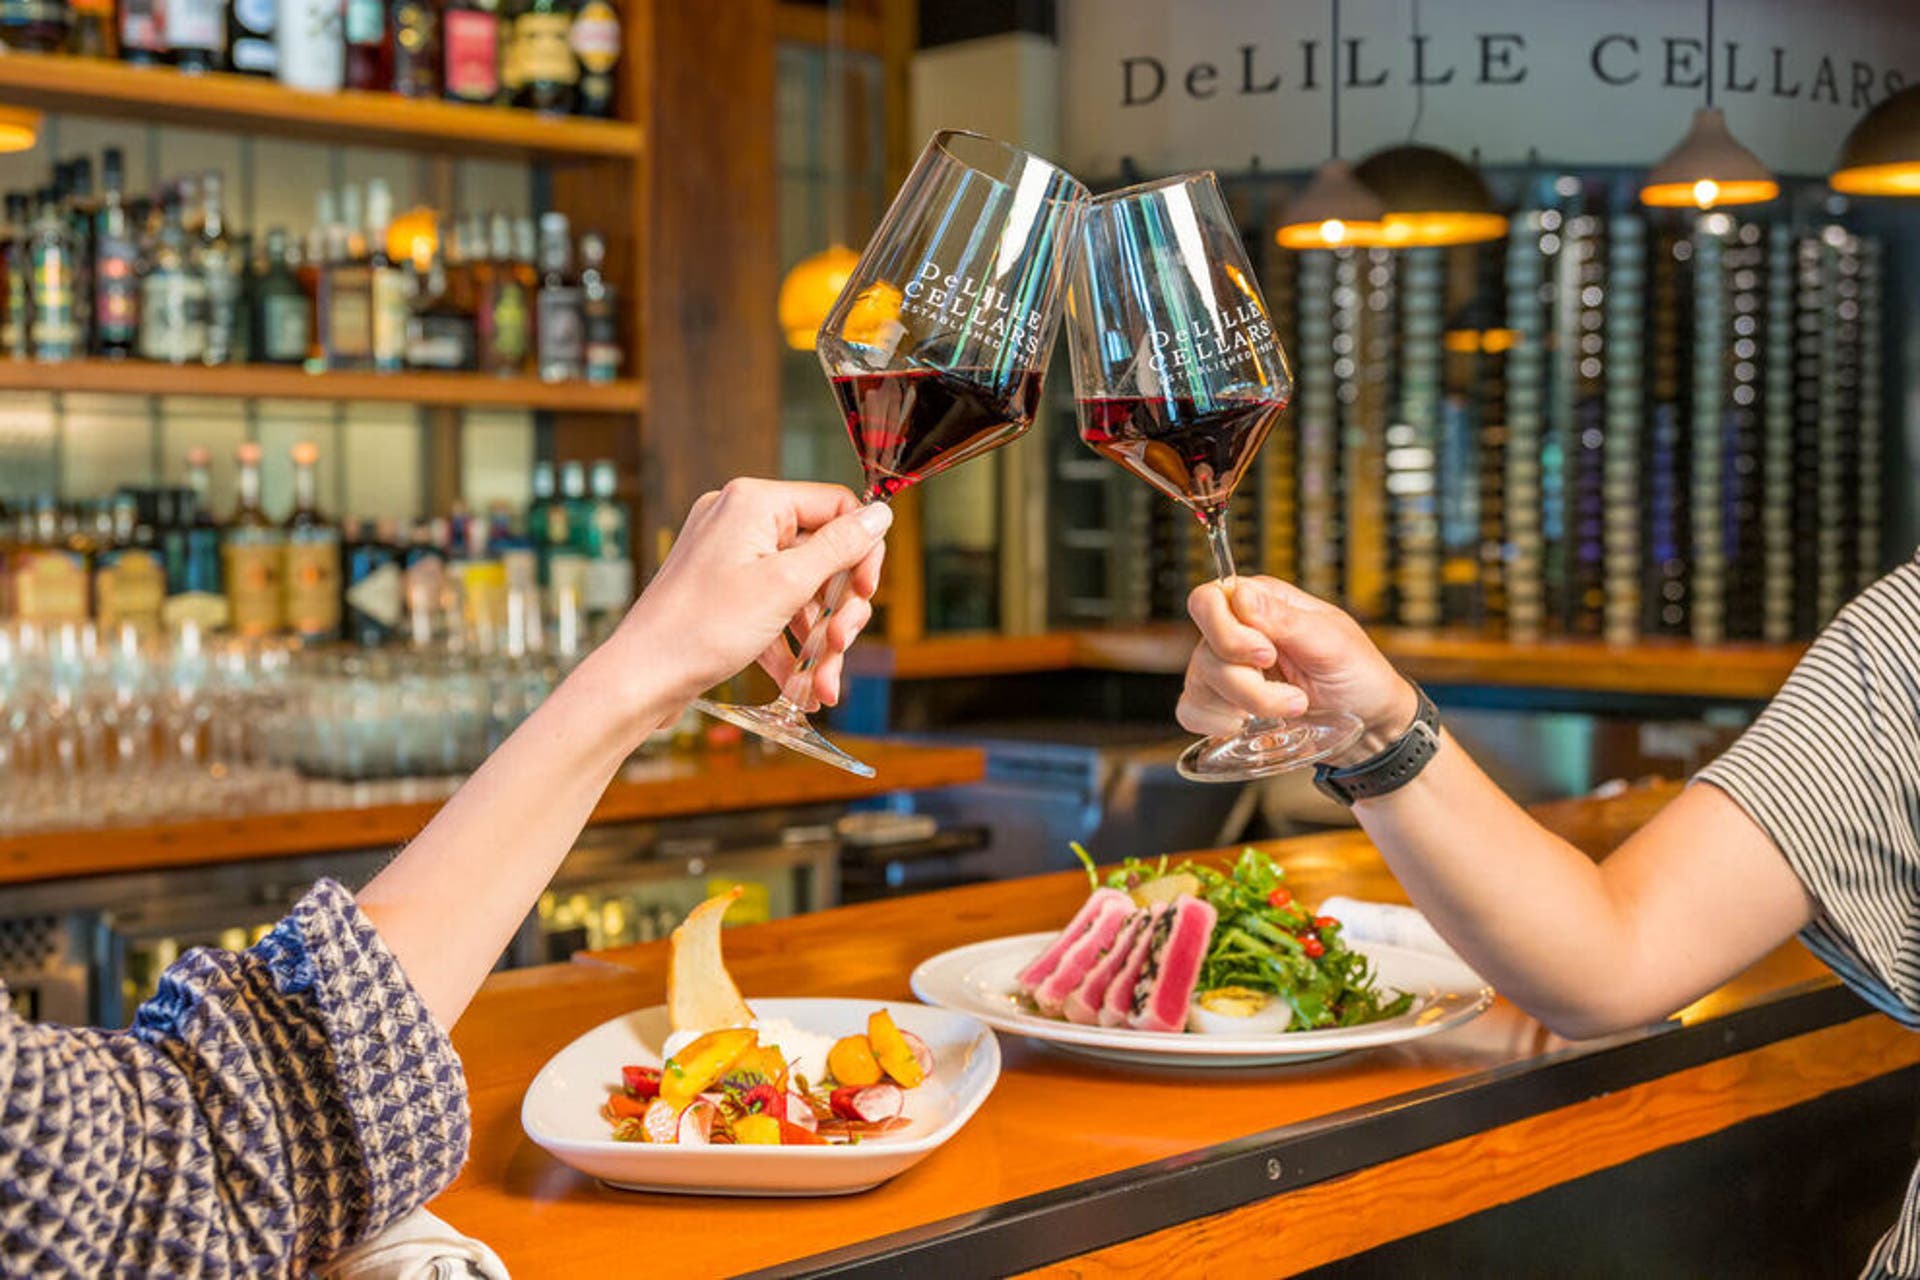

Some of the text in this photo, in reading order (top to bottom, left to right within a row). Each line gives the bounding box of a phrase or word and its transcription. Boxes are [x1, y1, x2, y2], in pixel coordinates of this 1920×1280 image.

[1120, 32, 1529, 108] DeLILLE
[905, 281, 1039, 354] CELLARS
[1149, 320, 1271, 371] CELLARS
[1151, 300, 1262, 348] DeLLLE
